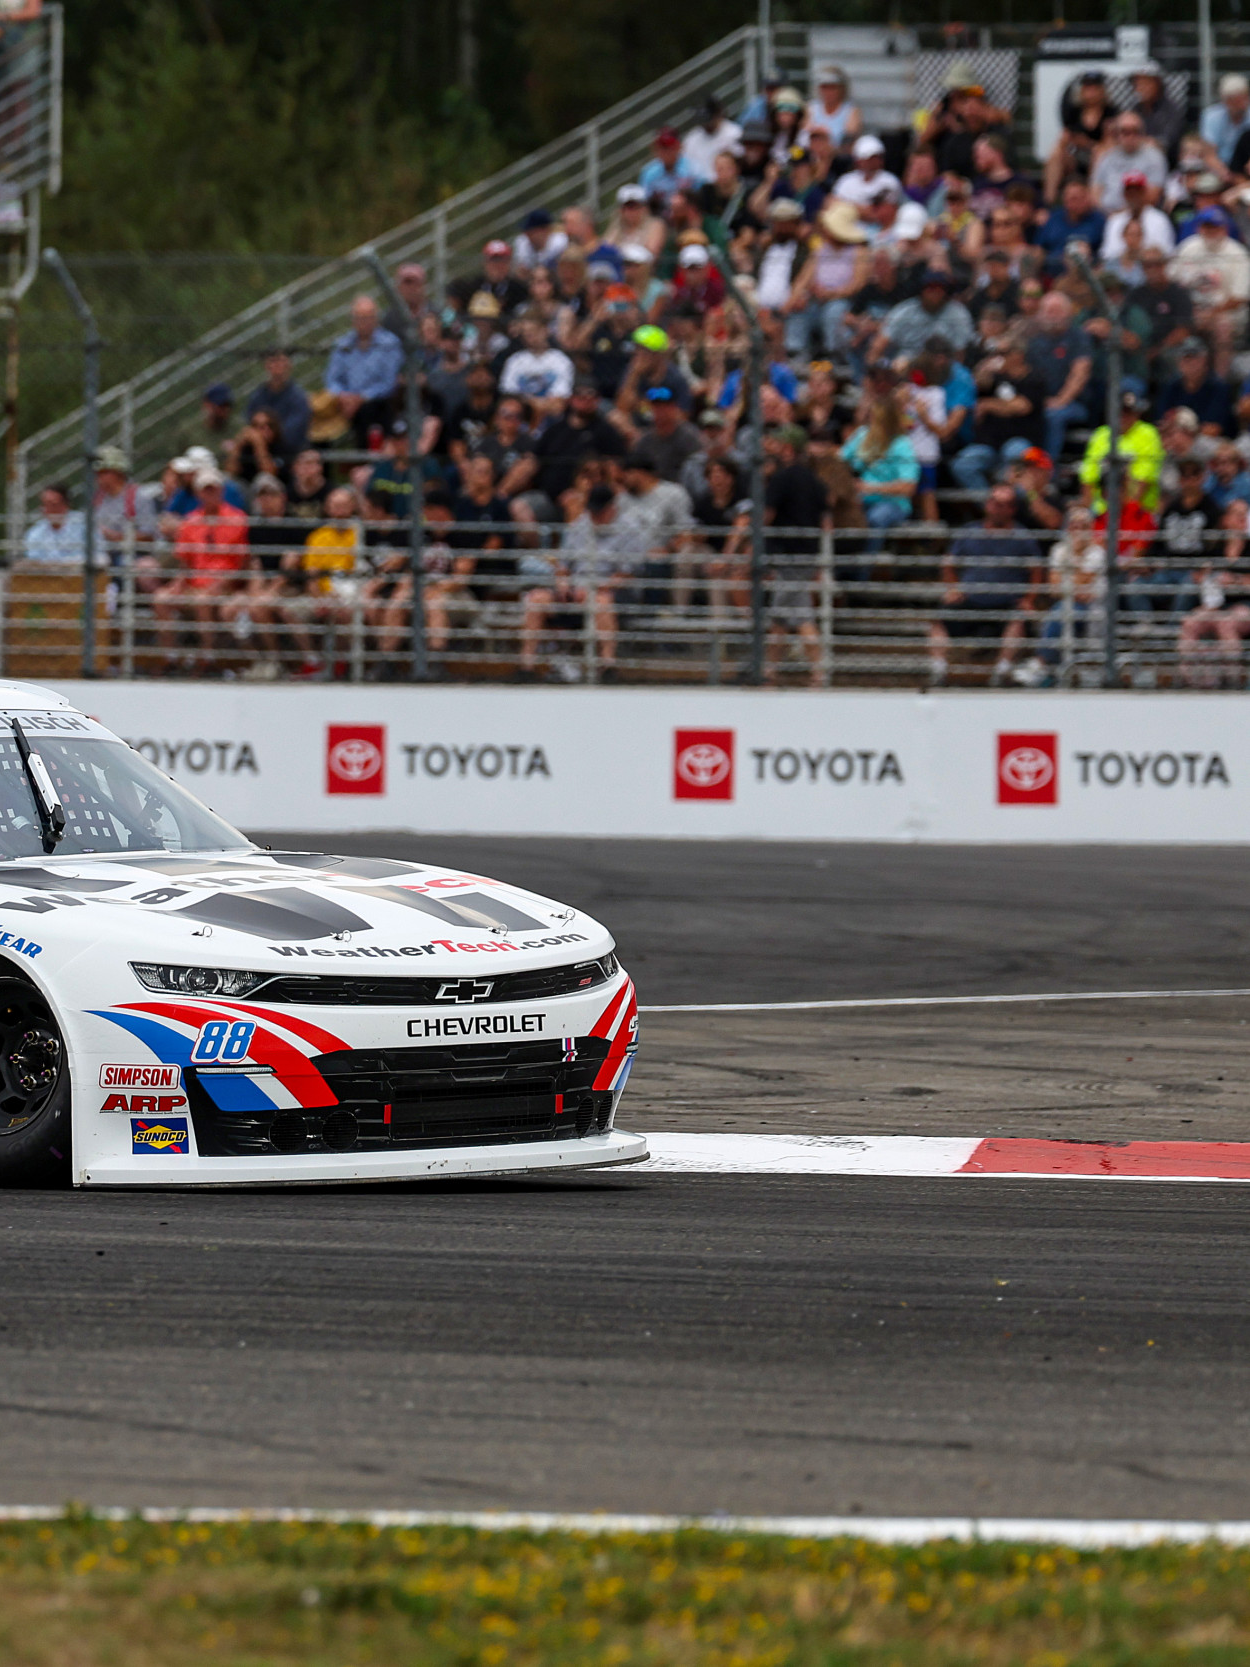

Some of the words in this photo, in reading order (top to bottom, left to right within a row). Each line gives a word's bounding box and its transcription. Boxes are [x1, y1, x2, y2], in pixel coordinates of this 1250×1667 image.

[123, 737, 261, 774] OYOTA
[400, 743, 551, 779] TOYOTA
[751, 746, 904, 784] TOYOTA
[1075, 750, 1230, 788] TOYOTA
[267, 931, 589, 958] WeatherTech.com
[195, 1021, 257, 1060] 88
[406, 1013, 547, 1038] CHEVROLET
[104, 1067, 174, 1086] SIMPSON
[100, 1093, 187, 1112] ARP
[135, 1131, 185, 1142] SUNOCO
